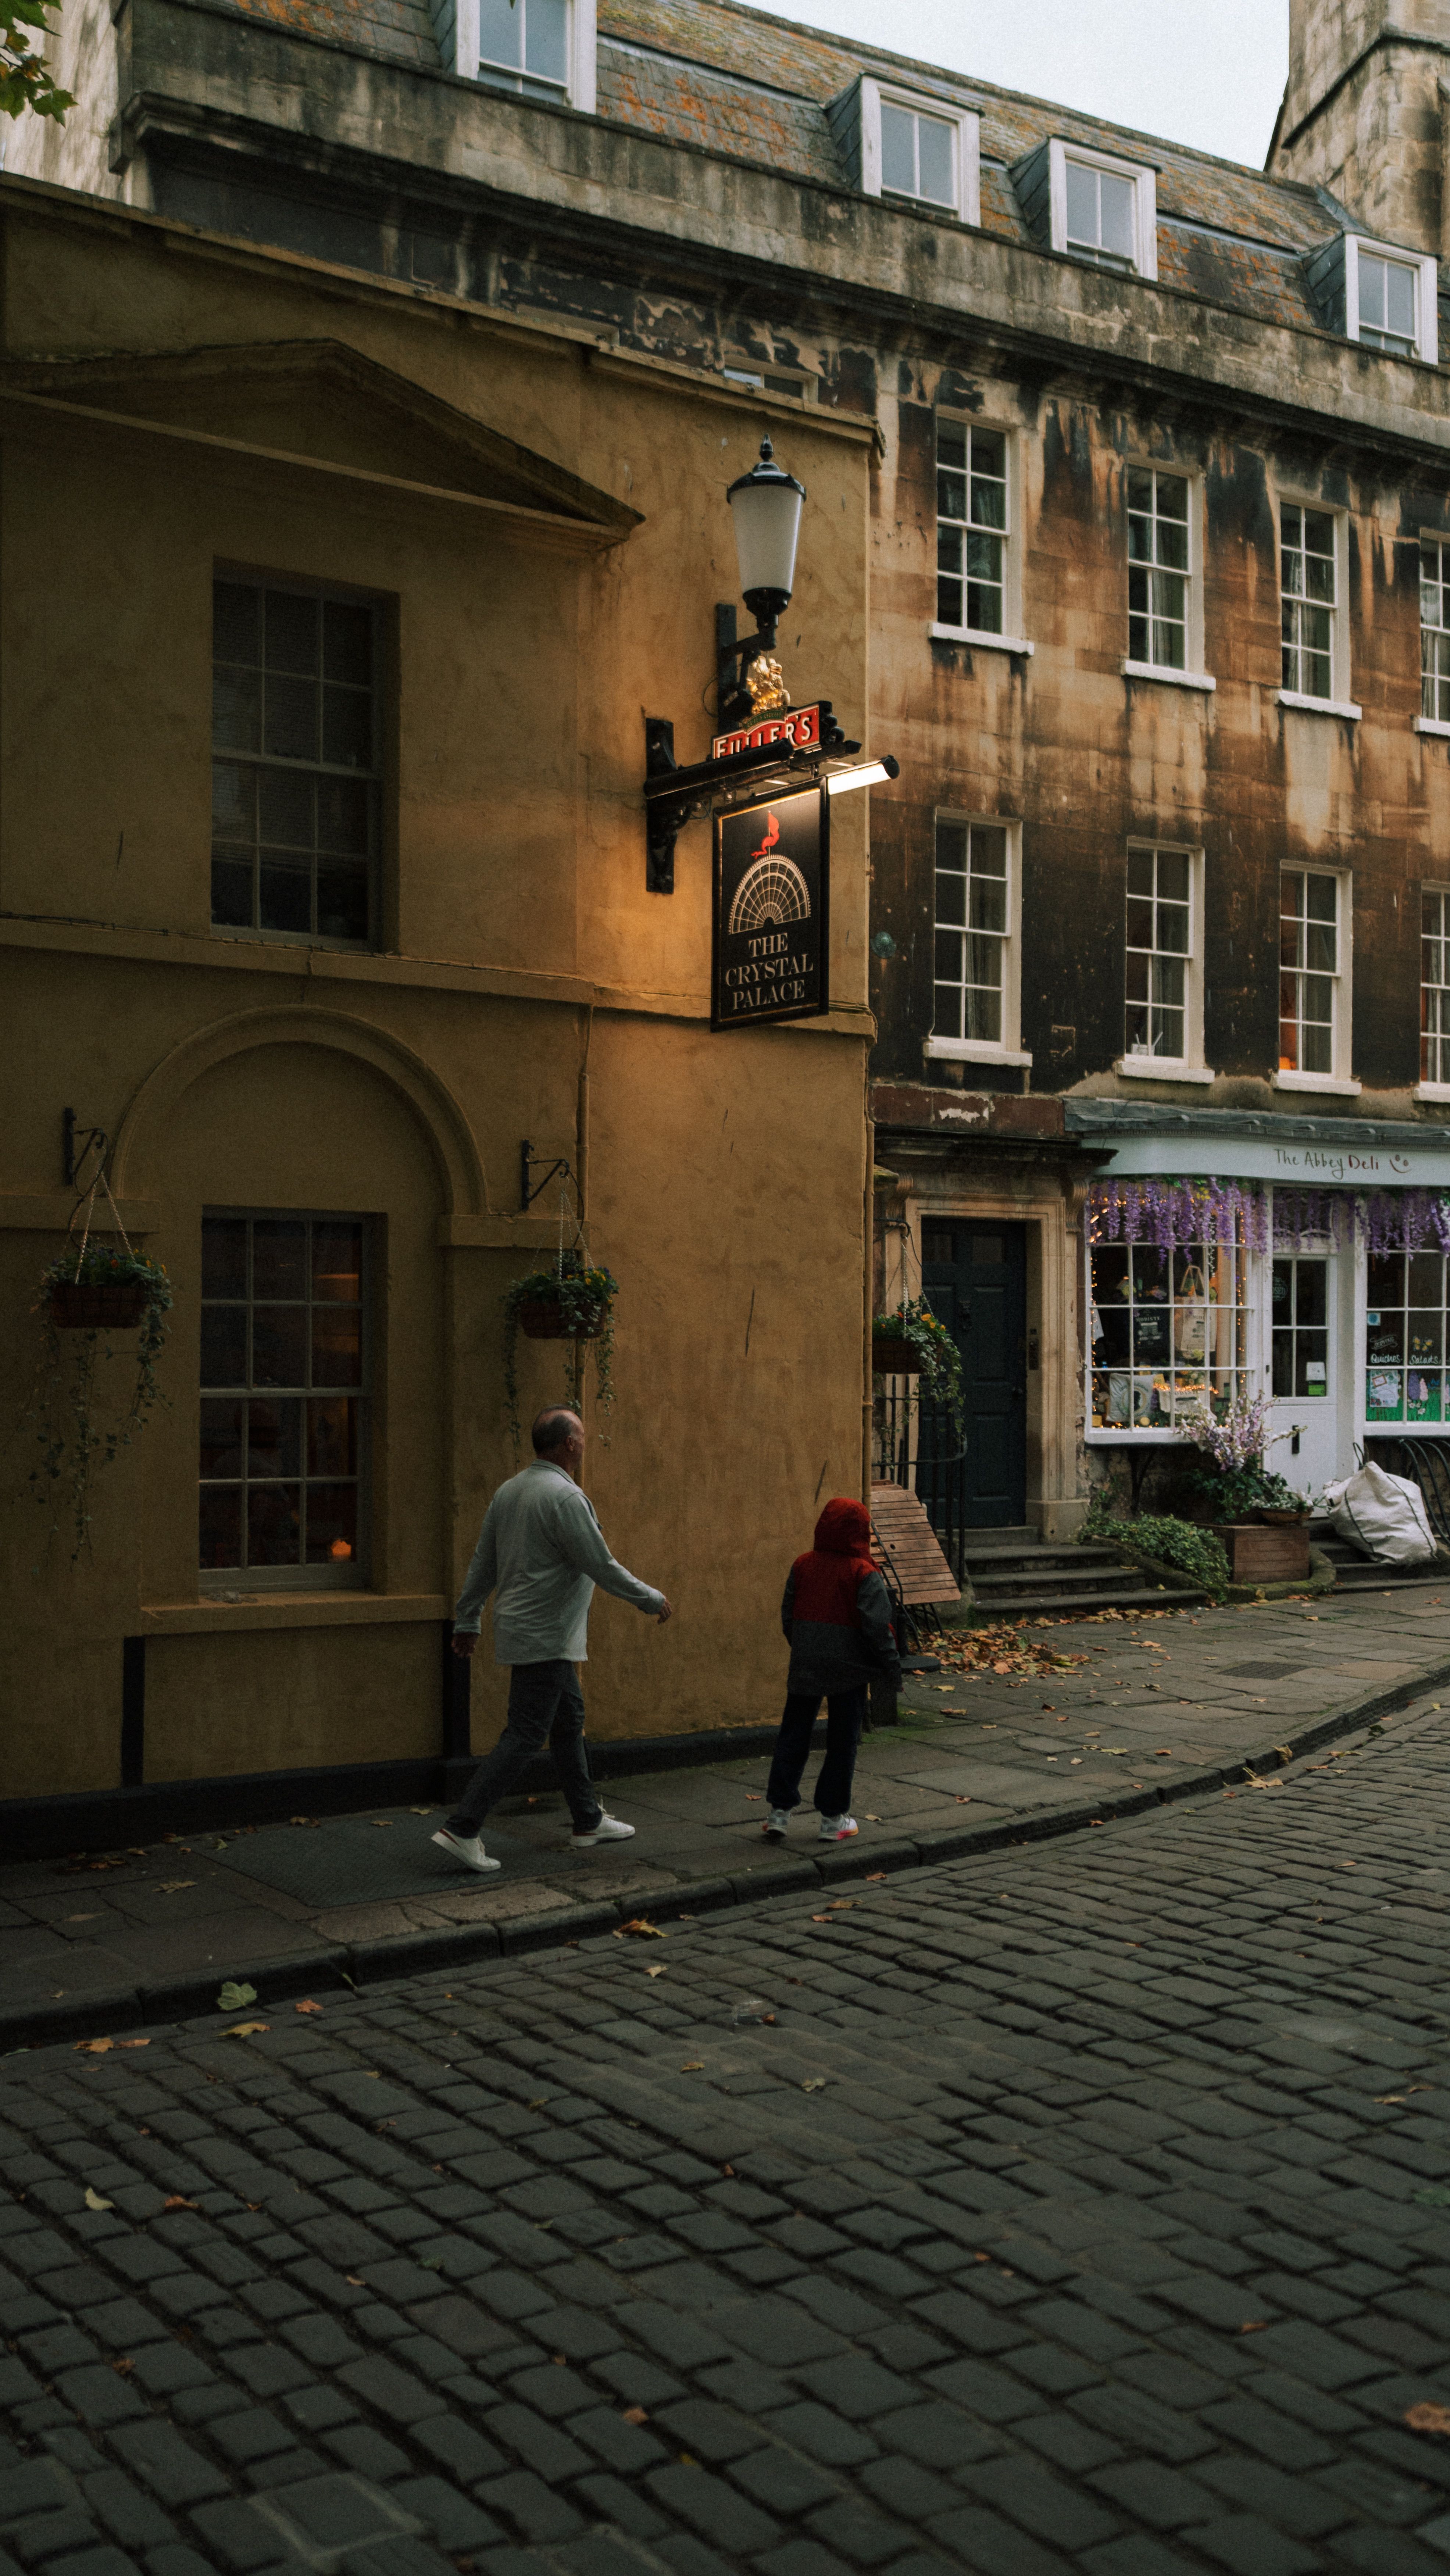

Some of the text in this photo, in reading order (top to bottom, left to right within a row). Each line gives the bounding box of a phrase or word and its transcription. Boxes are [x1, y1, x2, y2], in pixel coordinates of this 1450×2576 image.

[749, 933, 788, 958] THE
[725, 954, 814, 987] CRYSTAL
[733, 980, 805, 1010] PALACE
[1274, 1149, 1379, 1180] The Abbey Deli
